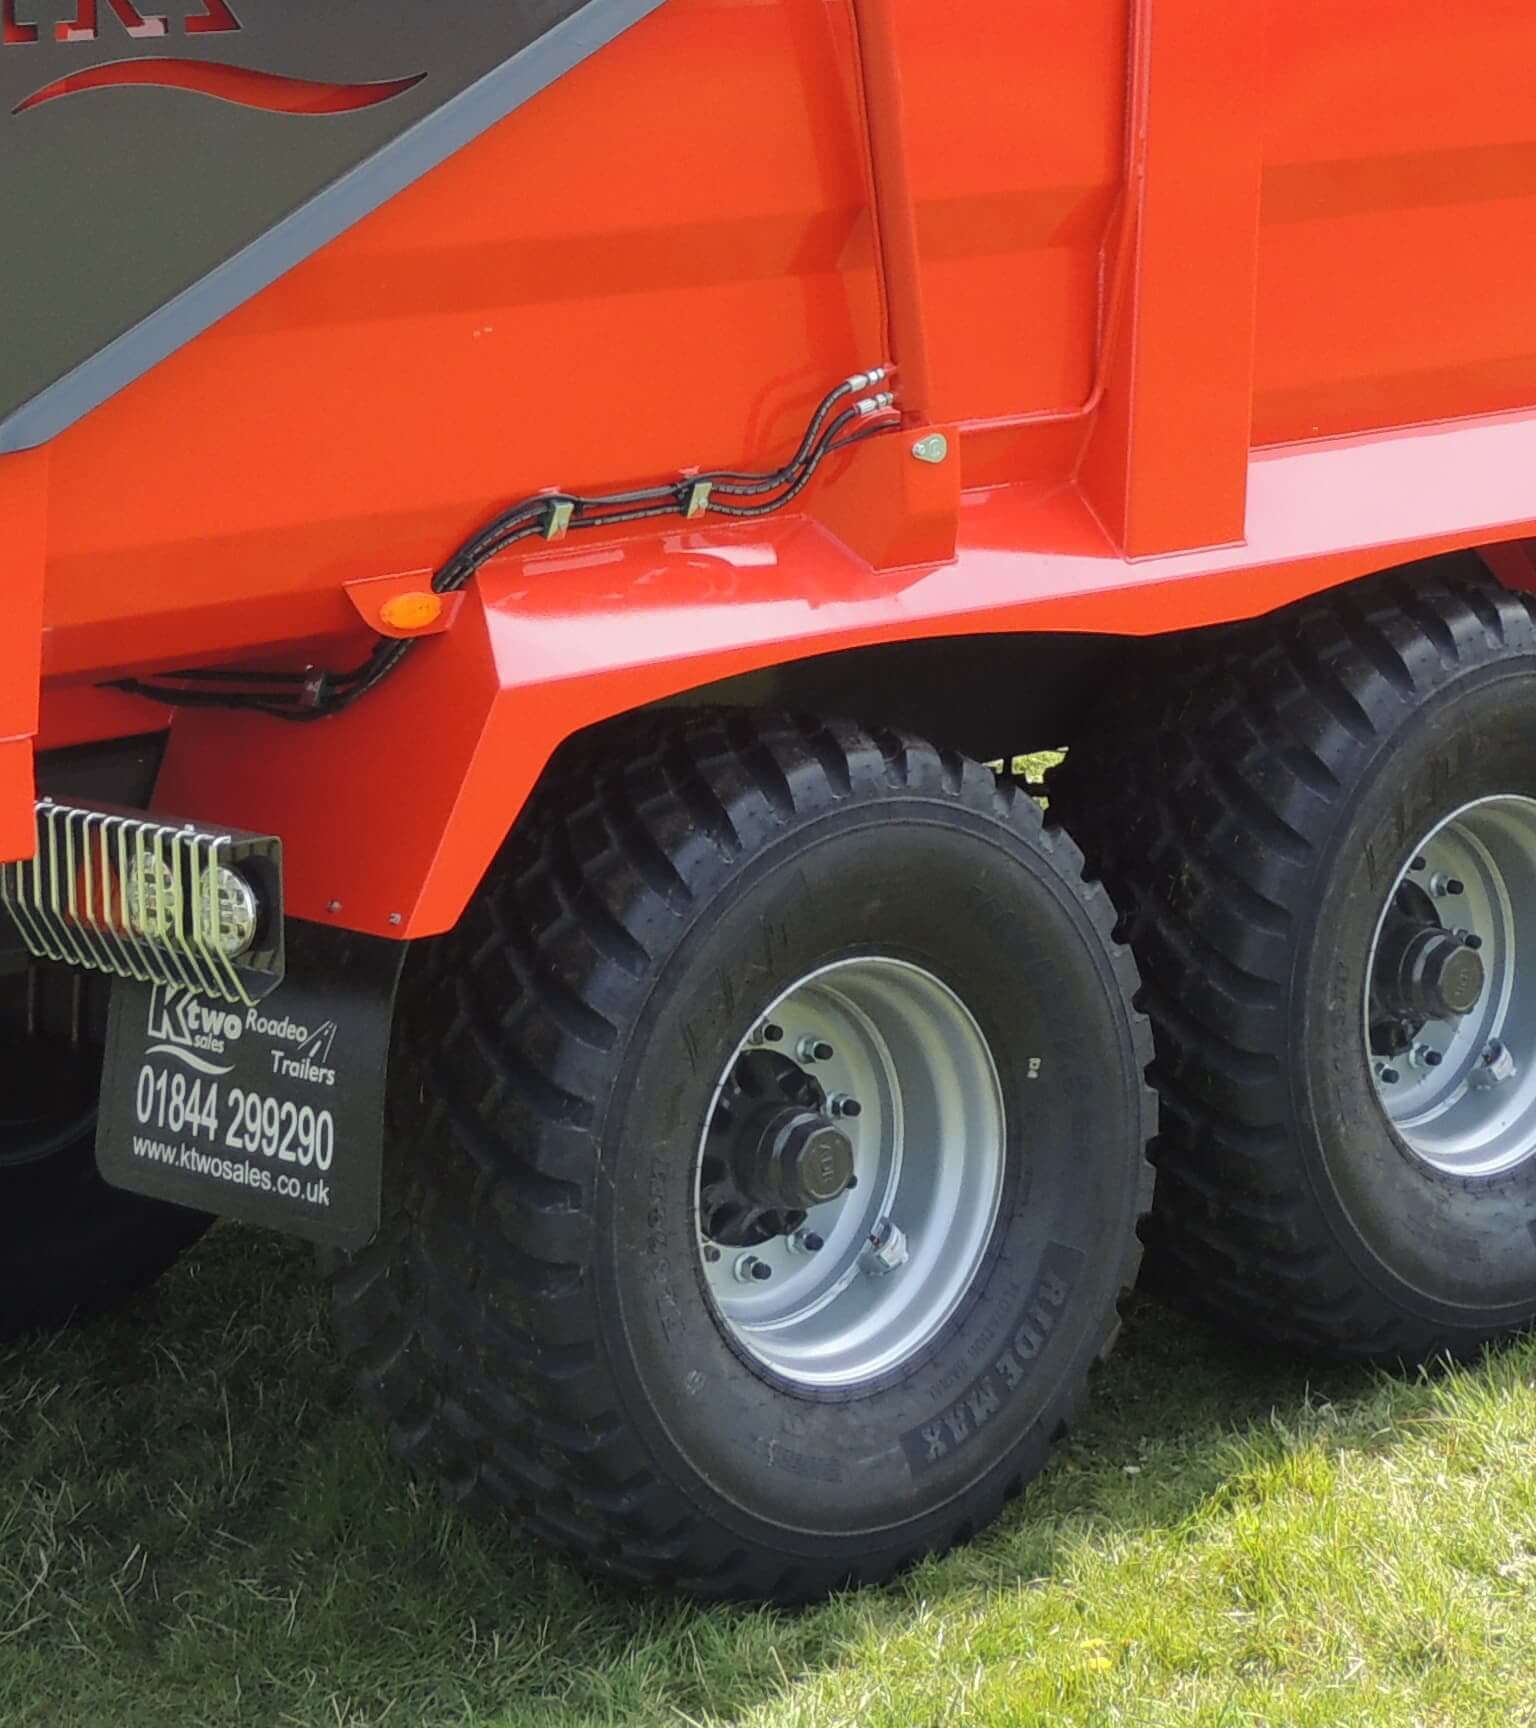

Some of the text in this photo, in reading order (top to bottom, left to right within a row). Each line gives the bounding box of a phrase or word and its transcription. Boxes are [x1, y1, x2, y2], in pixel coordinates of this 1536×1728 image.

[147, 981, 308, 1047] Ktwo Roadeo
[192, 1032, 225, 1054] sales
[270, 1049, 336, 1086] Trailers
[136, 1064, 335, 1171] 01844 299290
[132, 1135, 330, 1206] www.ktwosales.co.uk
[996, 1271, 1066, 1392] RIDE
[920, 1374, 1001, 1462] MAX
